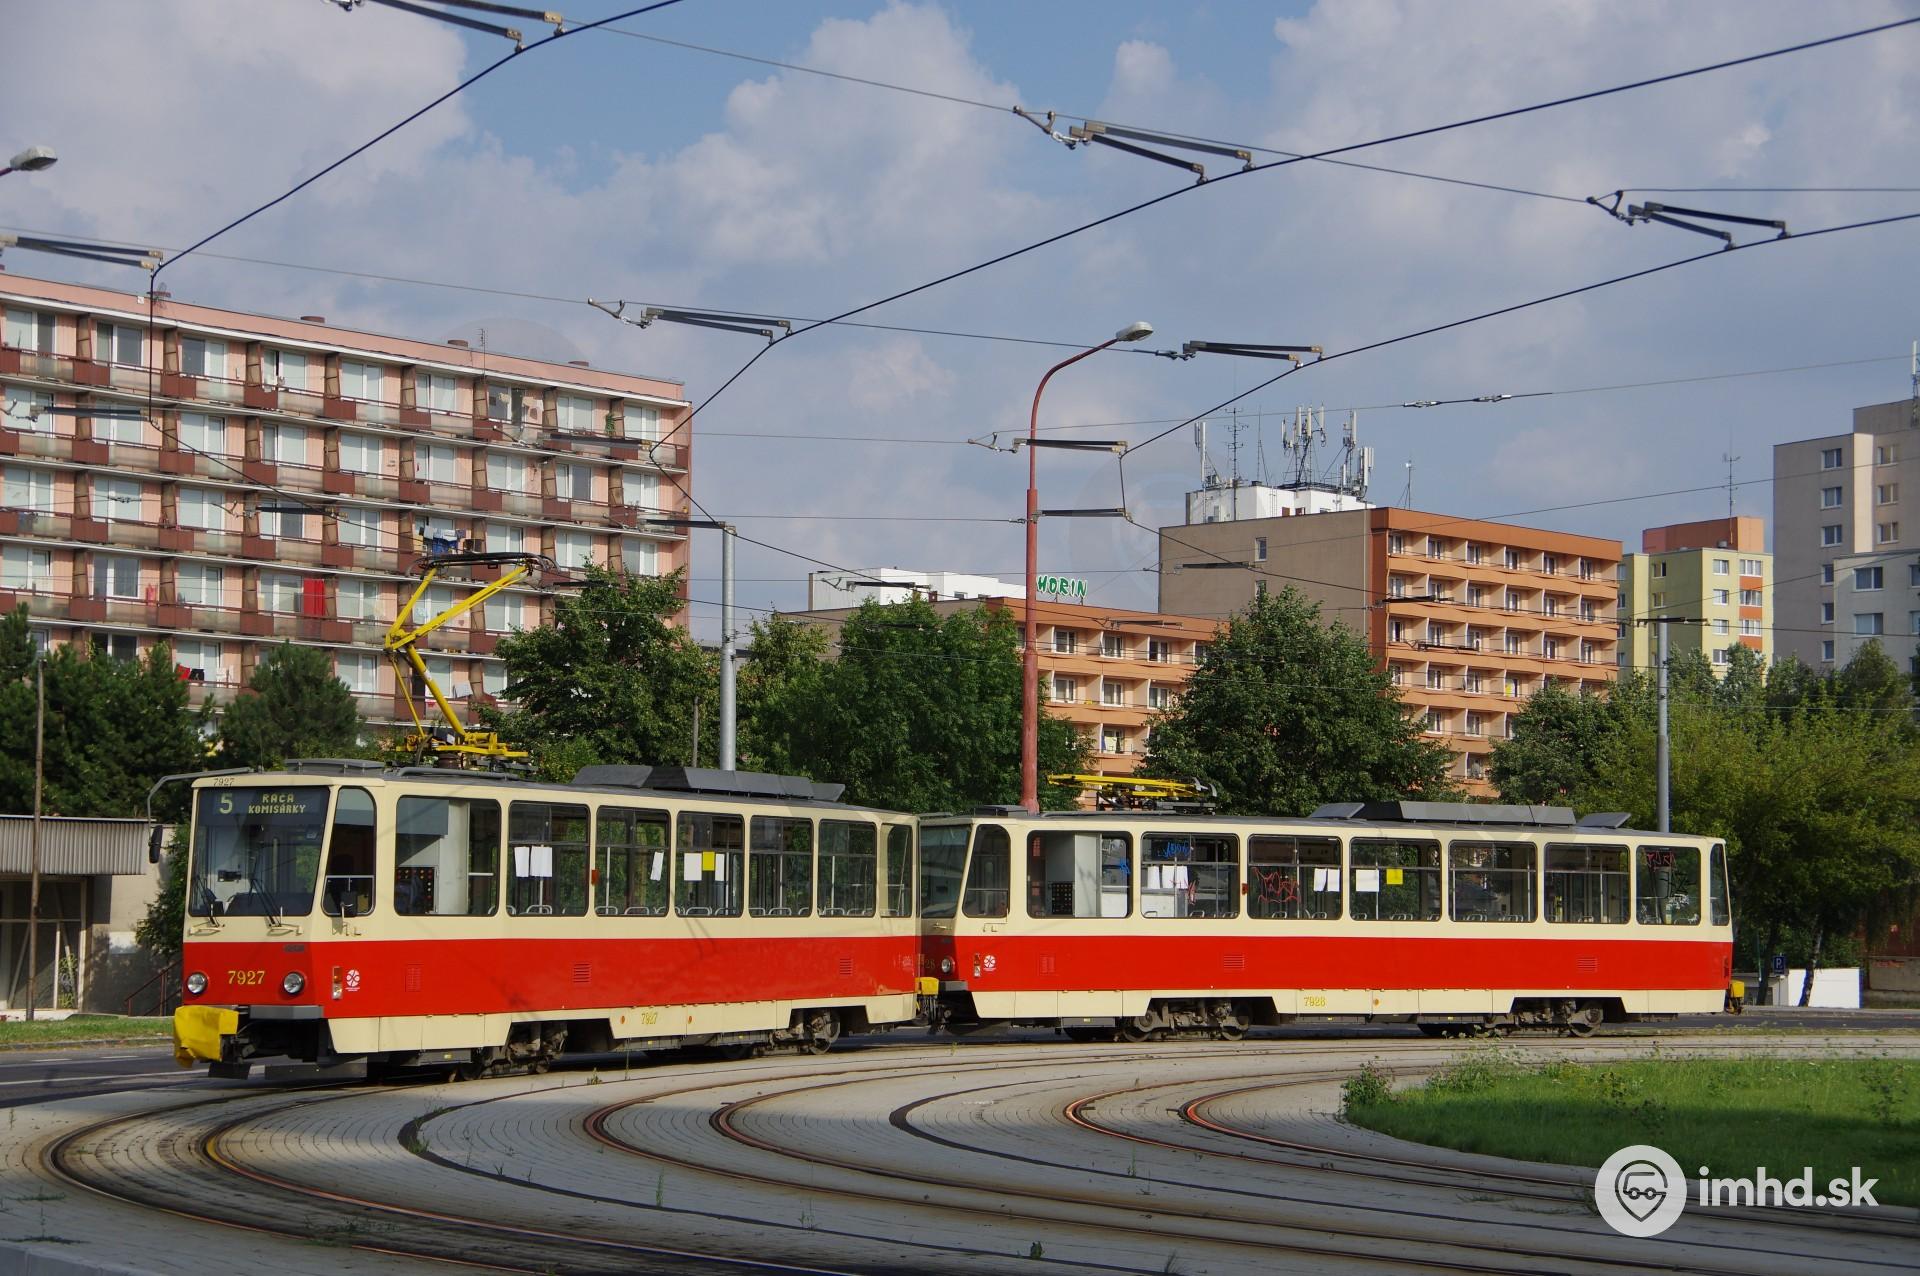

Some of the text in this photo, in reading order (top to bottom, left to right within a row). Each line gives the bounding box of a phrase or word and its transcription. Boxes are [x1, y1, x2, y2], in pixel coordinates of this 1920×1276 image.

[213, 777, 235, 787] 7927
[219, 792, 233, 814] 5
[227, 970, 265, 985] 7927
